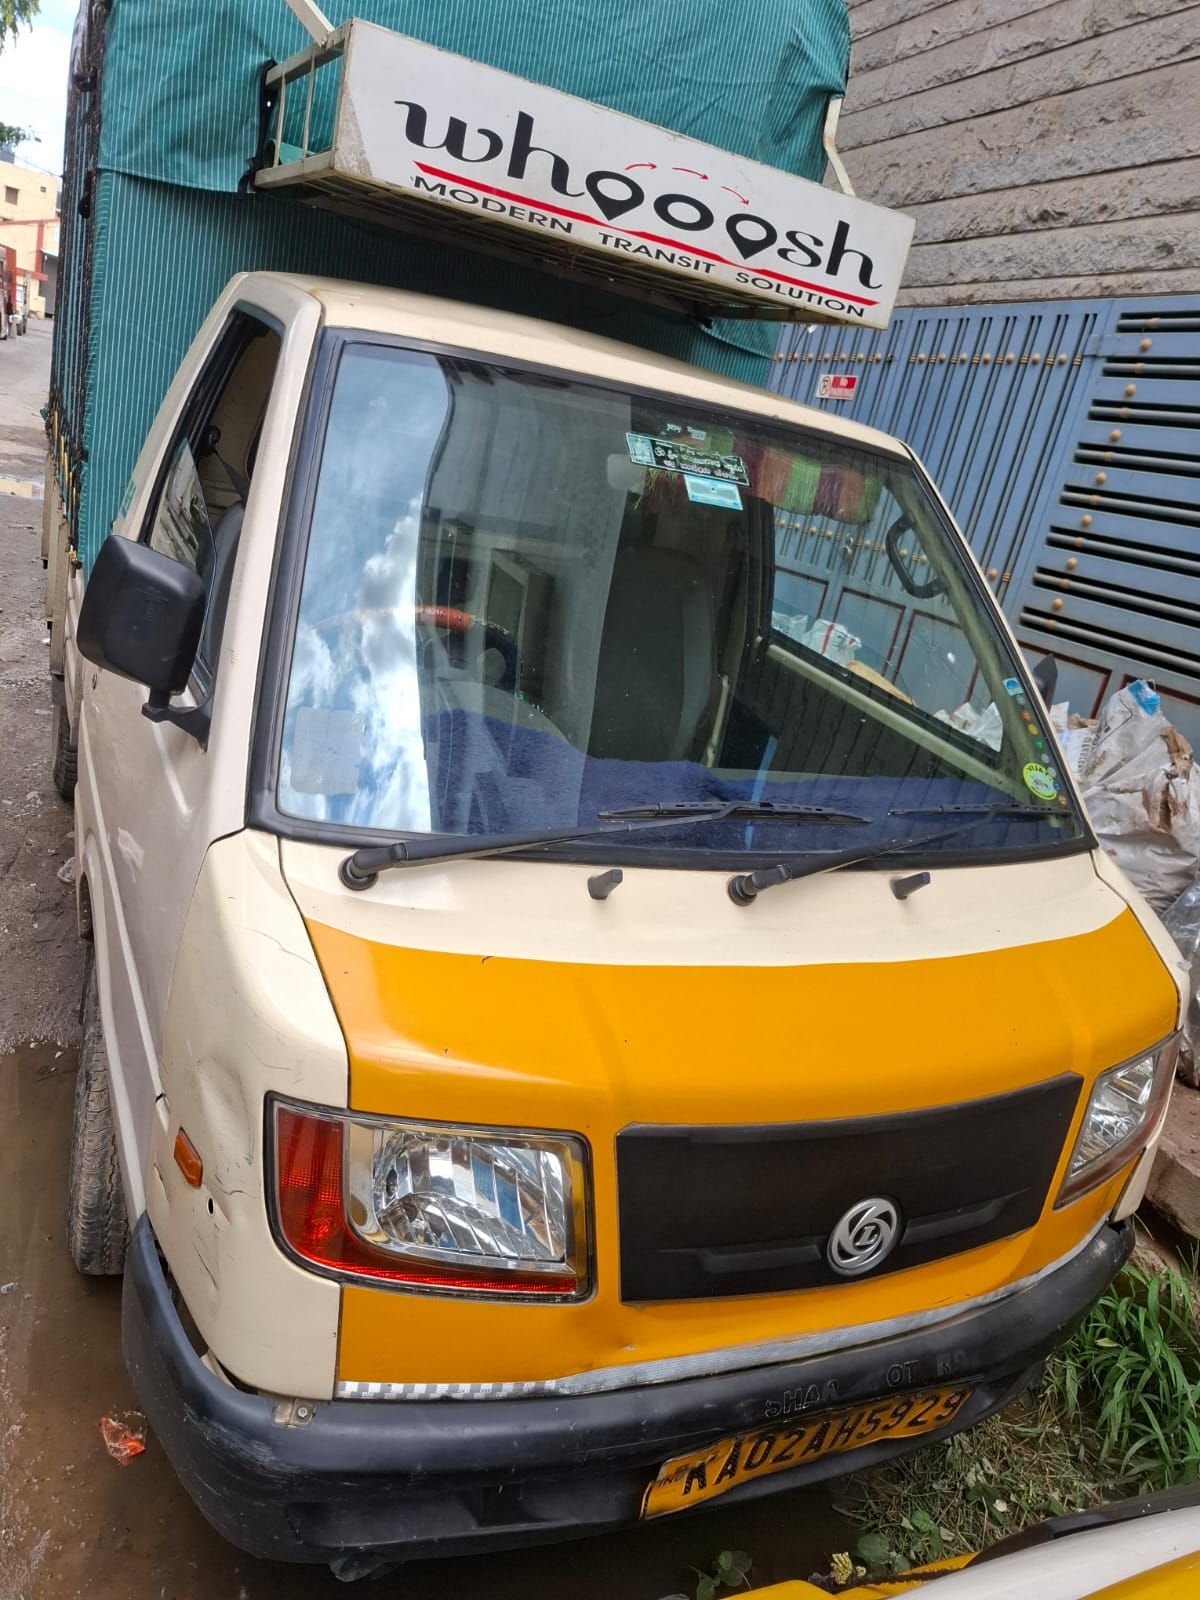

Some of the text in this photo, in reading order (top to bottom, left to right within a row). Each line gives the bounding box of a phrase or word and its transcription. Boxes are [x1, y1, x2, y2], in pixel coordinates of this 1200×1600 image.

[413, 175, 866, 319] MODERN TRANSIT SOLUTION
[682, 1389, 970, 1496] KA02AH5929
